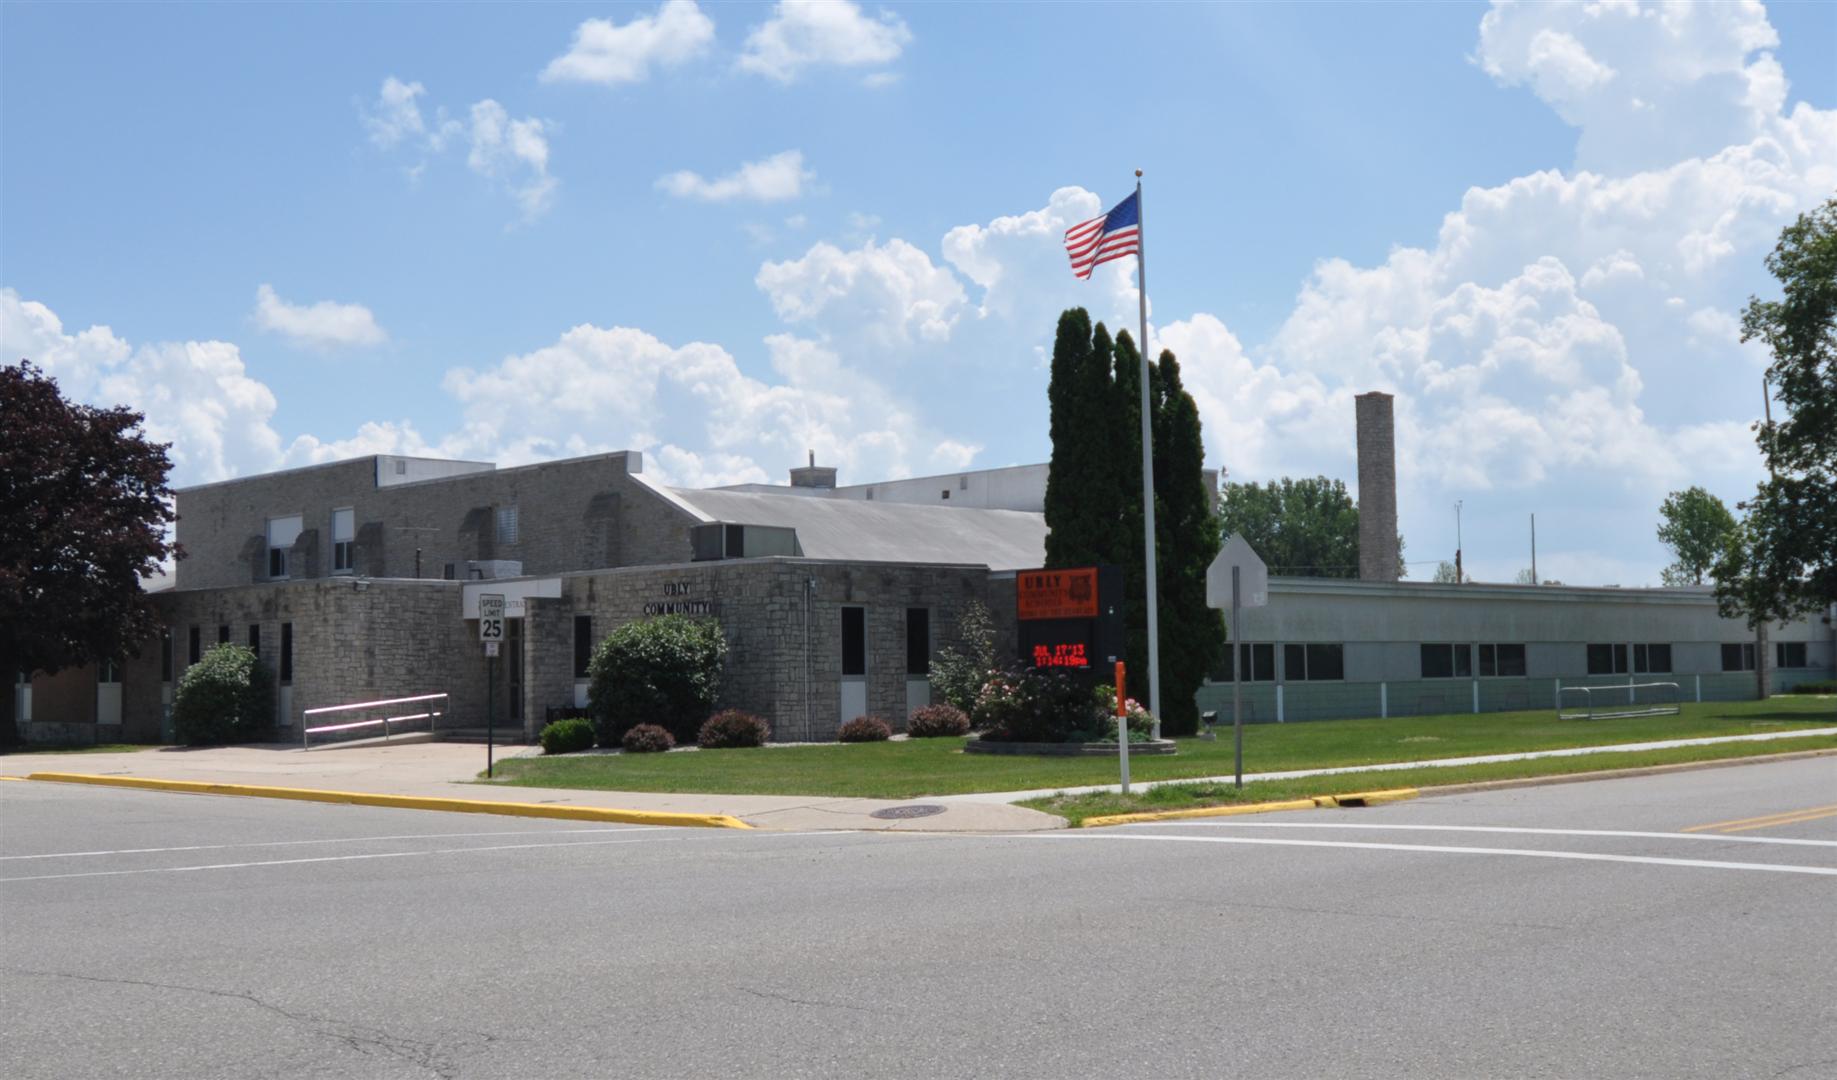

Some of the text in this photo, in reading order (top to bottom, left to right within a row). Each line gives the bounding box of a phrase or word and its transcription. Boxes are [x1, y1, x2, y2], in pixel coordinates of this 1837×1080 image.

[1025, 576, 1061, 589] UBLY
[664, 583, 689, 596] UBLY
[482, 599, 502, 607] SPEED
[643, 601, 710, 615] COMMUNITY
[483, 620, 501, 637] 25
